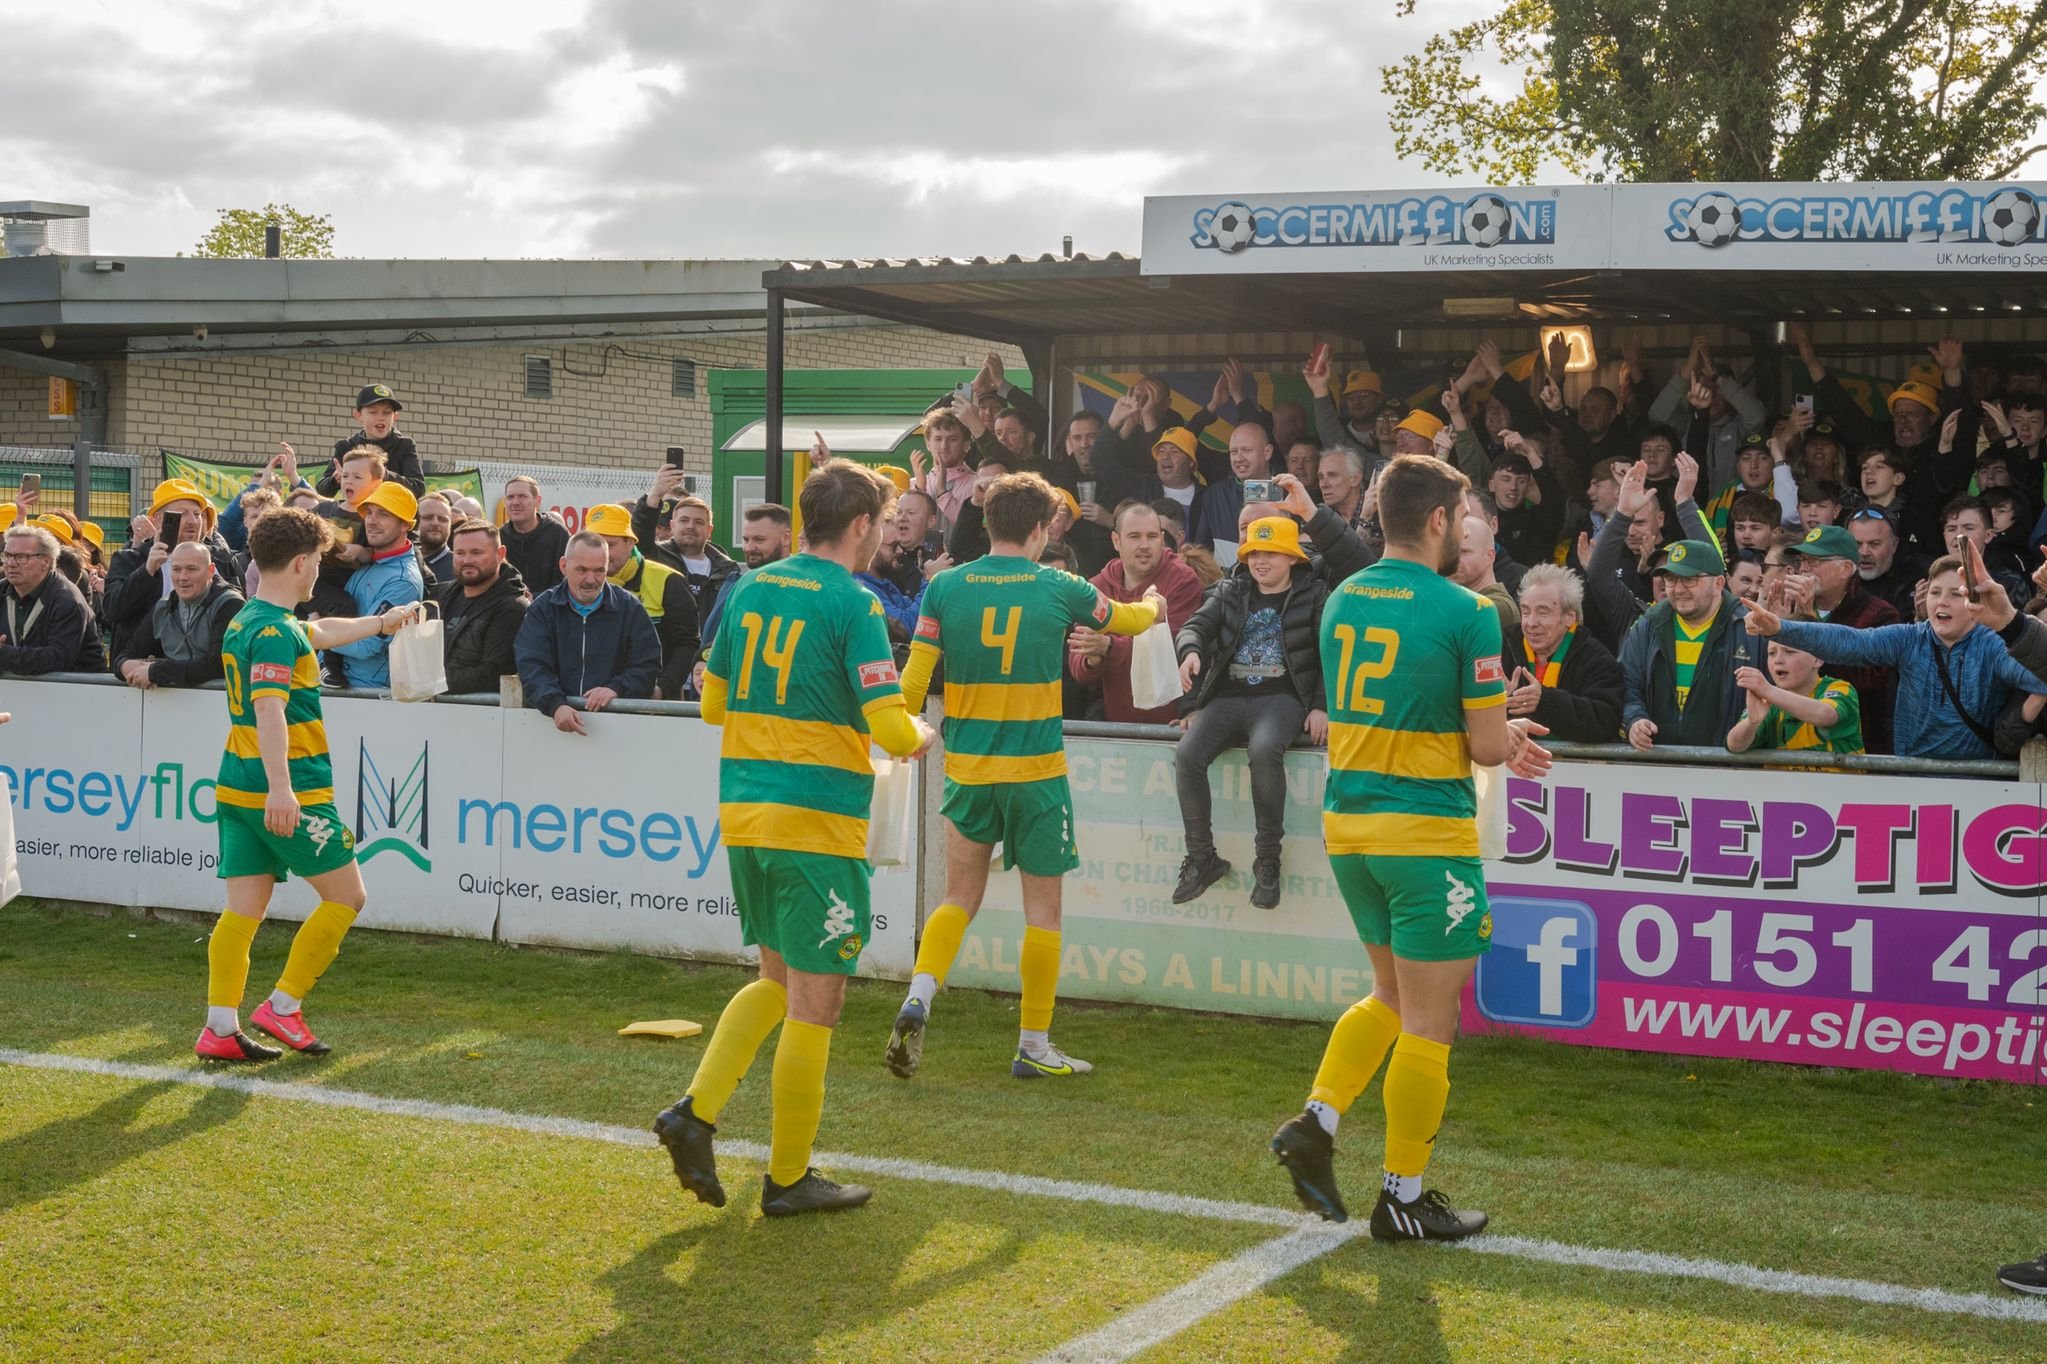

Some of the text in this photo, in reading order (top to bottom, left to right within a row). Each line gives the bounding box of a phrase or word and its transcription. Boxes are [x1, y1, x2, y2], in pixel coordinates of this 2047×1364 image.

[1424, 253, 1554, 267] UK Marketing Specialists
[1937, 253, 1952, 265] UK
[1956, 252, 2021, 267] Marketing
[755, 572, 822, 591] Grangeside
[965, 573, 1037, 585] Grangeside
[1343, 583, 1414, 600] Grangeside
[736, 612, 806, 705] 14
[981, 606, 1023, 675] 4
[1333, 624, 1400, 715] 12
[1069, 755, 1128, 793] CE
[15, 838, 62, 860] asier,
[70, 843, 117, 861] more
[123, 845, 193, 866] reliable
[458, 873, 543, 902] Quicker,
[551, 884, 621, 909] easier,
[630, 892, 688, 912] more
[1122, 896, 1237, 922] 1966-2017
[959, 935, 1147, 985] ALAYS
[1162, 952, 1195, 990] A
[1617, 903, 1874, 993] 0151
[1622, 994, 2047, 1077] www.sleepti
